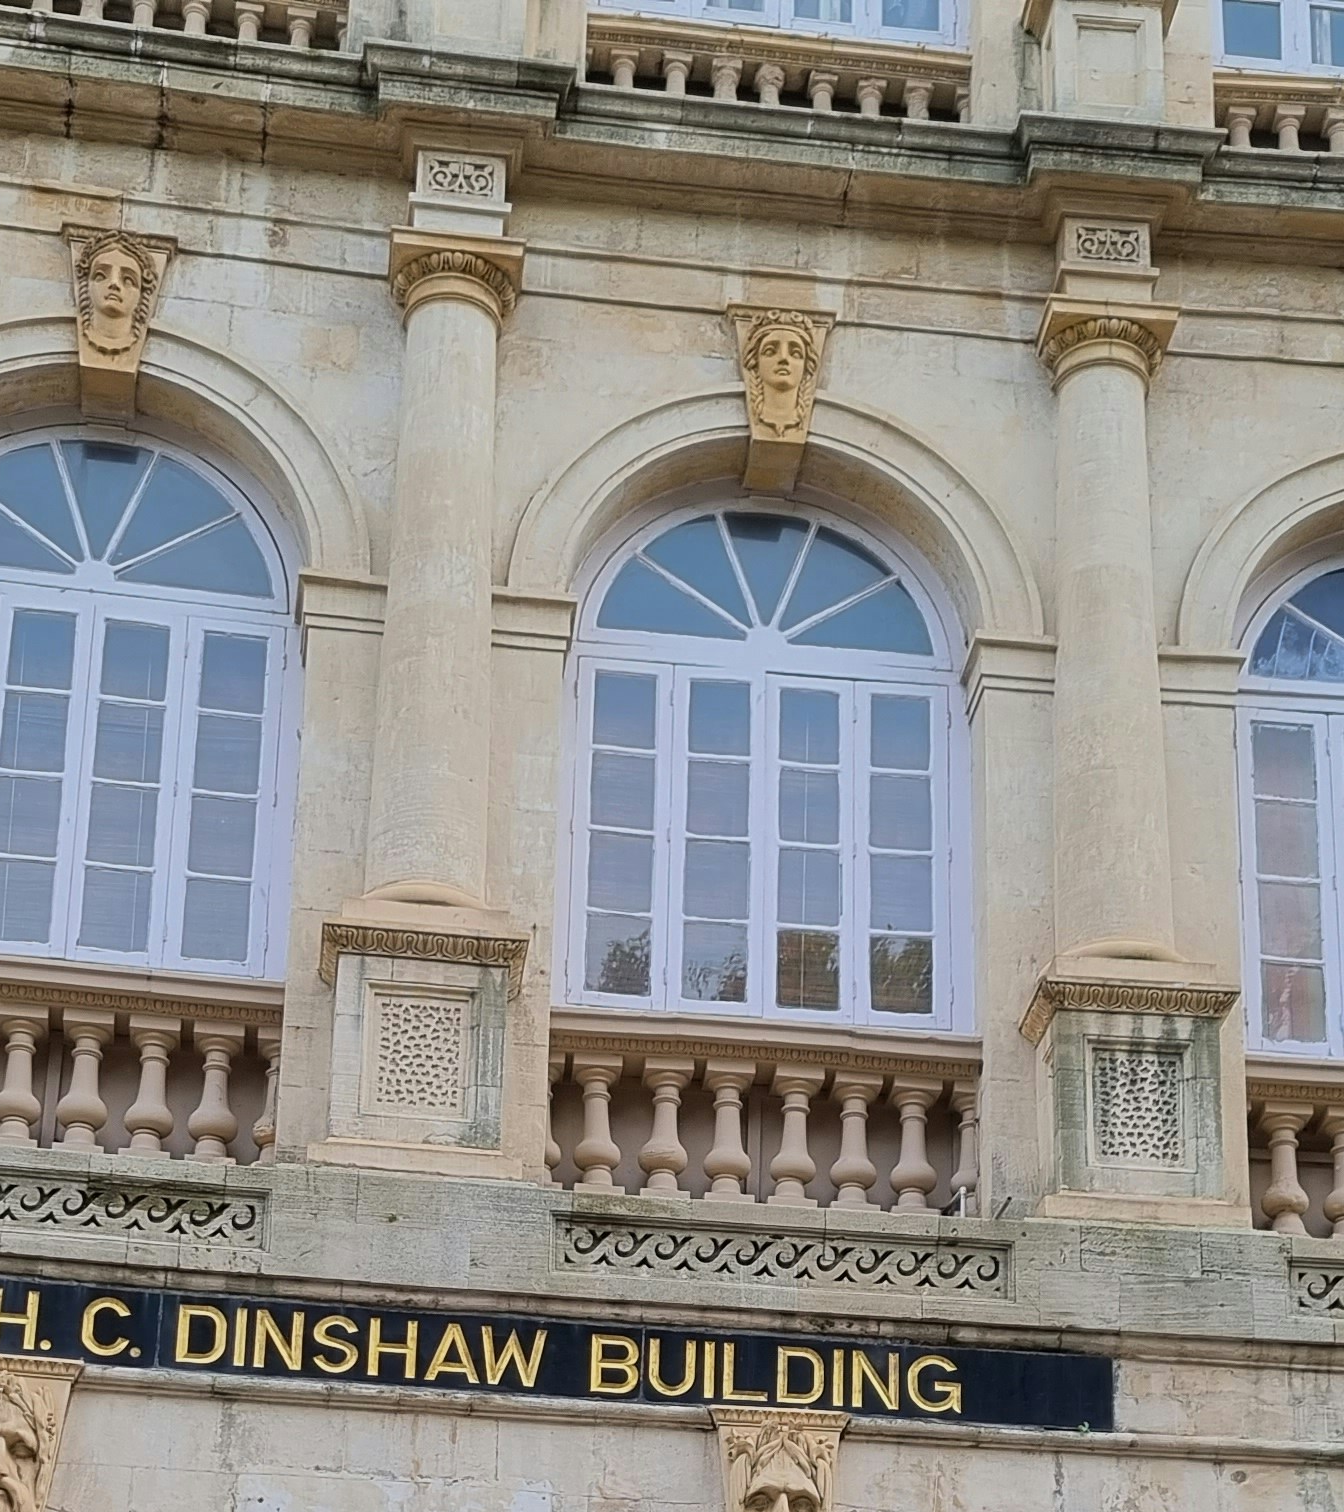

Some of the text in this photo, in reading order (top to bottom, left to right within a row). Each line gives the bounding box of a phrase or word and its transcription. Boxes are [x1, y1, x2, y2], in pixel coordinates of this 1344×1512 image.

[80, 1295, 141, 1360] C.
[175, 1304, 547, 1386] DINSHAW
[588, 1332, 961, 1414] BUILDING
